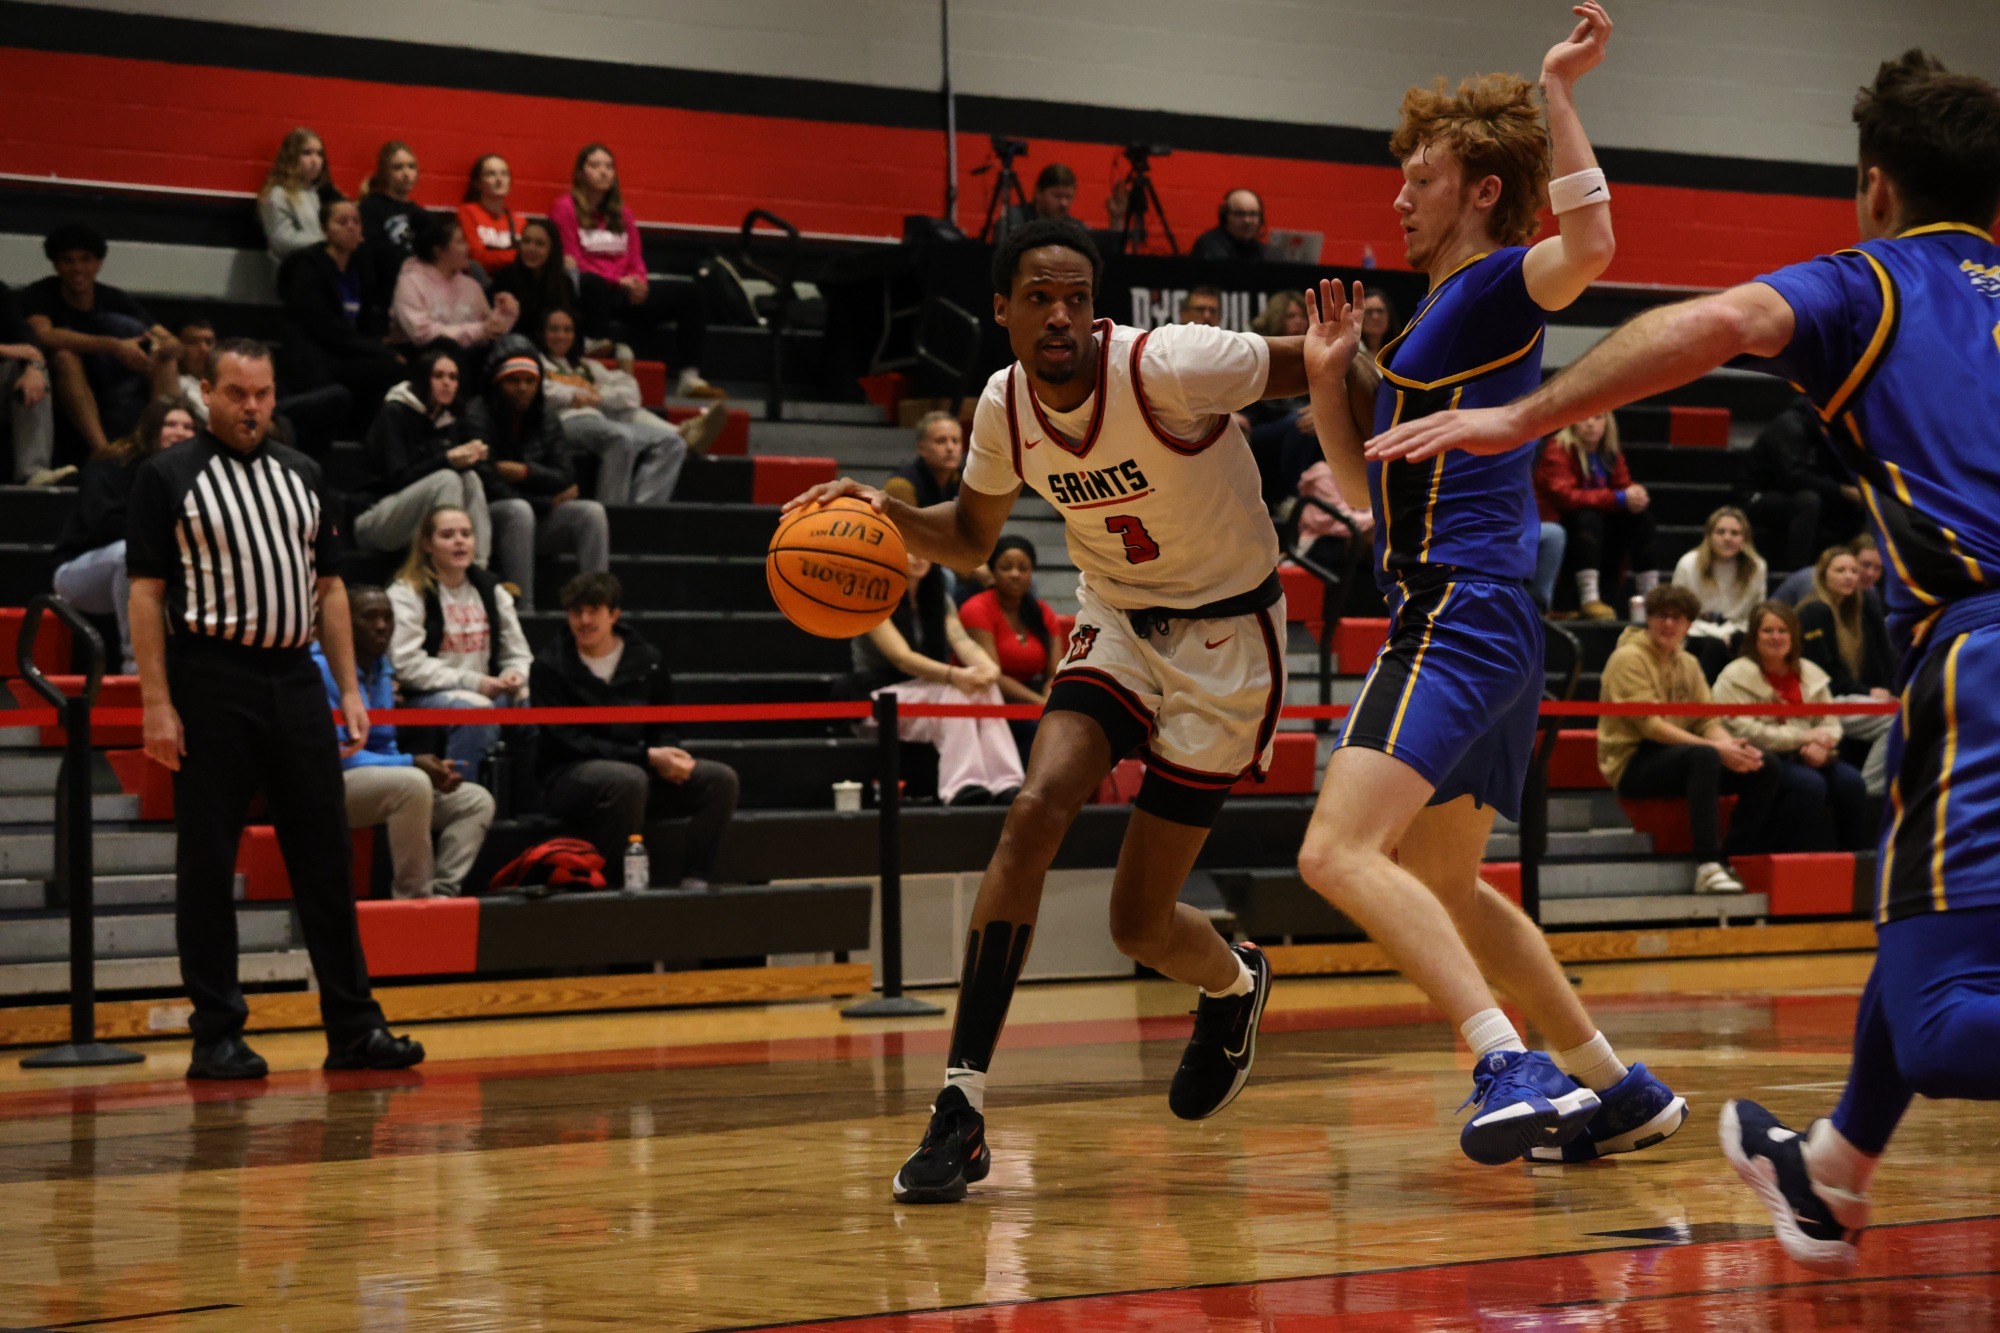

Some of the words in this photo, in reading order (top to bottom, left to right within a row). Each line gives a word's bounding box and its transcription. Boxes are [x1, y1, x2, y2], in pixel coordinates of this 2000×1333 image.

[1048, 458, 1149, 504] SAINTS
[828, 520, 884, 546] EVO
[1104, 514, 1160, 565] 3
[799, 557, 891, 602] Wilson
